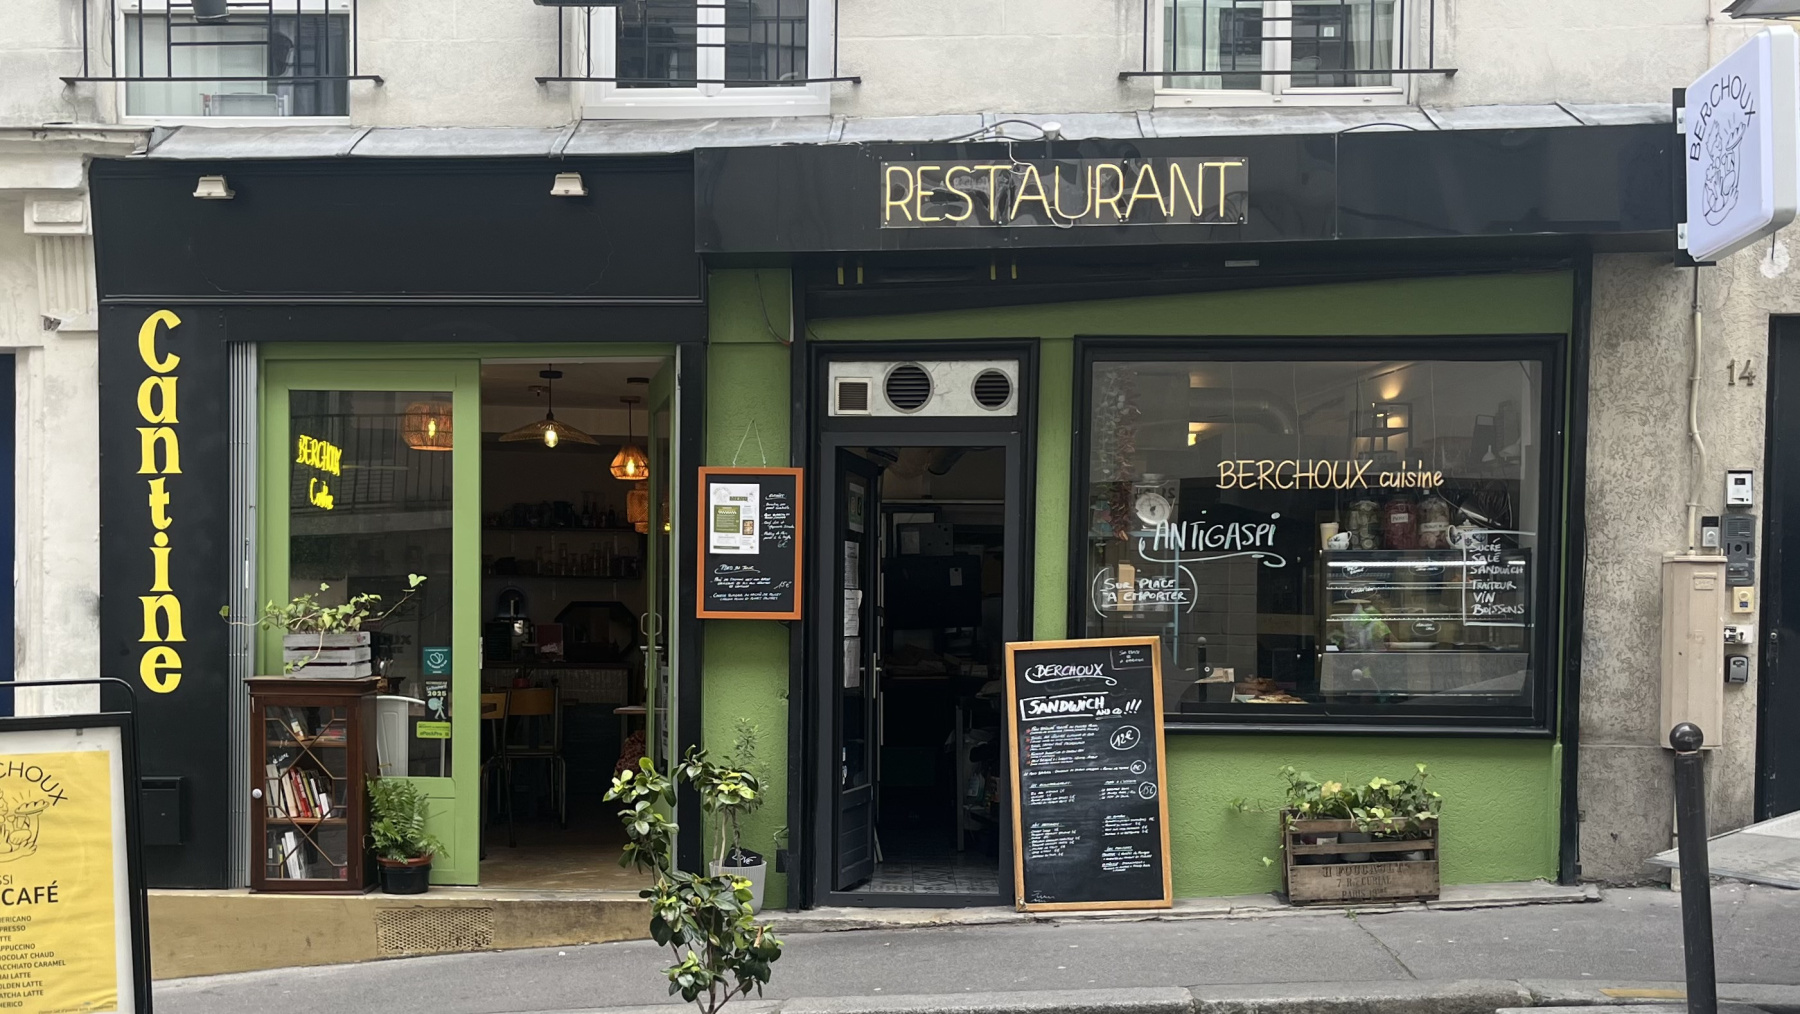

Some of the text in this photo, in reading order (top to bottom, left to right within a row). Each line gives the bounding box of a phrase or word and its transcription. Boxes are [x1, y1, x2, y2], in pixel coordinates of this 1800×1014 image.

[1689, 74, 1756, 161] BERCHOUX
[885, 162, 1243, 221] RESTAURANT
[1727, 359, 1756, 386] 14
[296, 434, 342, 476] BERCHOUX
[1216, 459, 1444, 490] BERCHOUX cuisine
[136, 309, 187, 693] Cantine
[1138, 577, 1176, 589] PLACE
[1123, 590, 1187, 602] EMPORTER
[1032, 663, 1104, 679] BERCHOUX
[1, 880, 59, 906] CAFÉ
[0, 943, 36, 952] PPUCCINO
[0, 951, 55, 961] OCOLAT CHAUD
[33, 959, 66, 969] CARAMEL
[10, 971, 32, 980] LATTE
[22, 980, 43, 988] LATTE
[23, 989, 44, 997] LATTE
